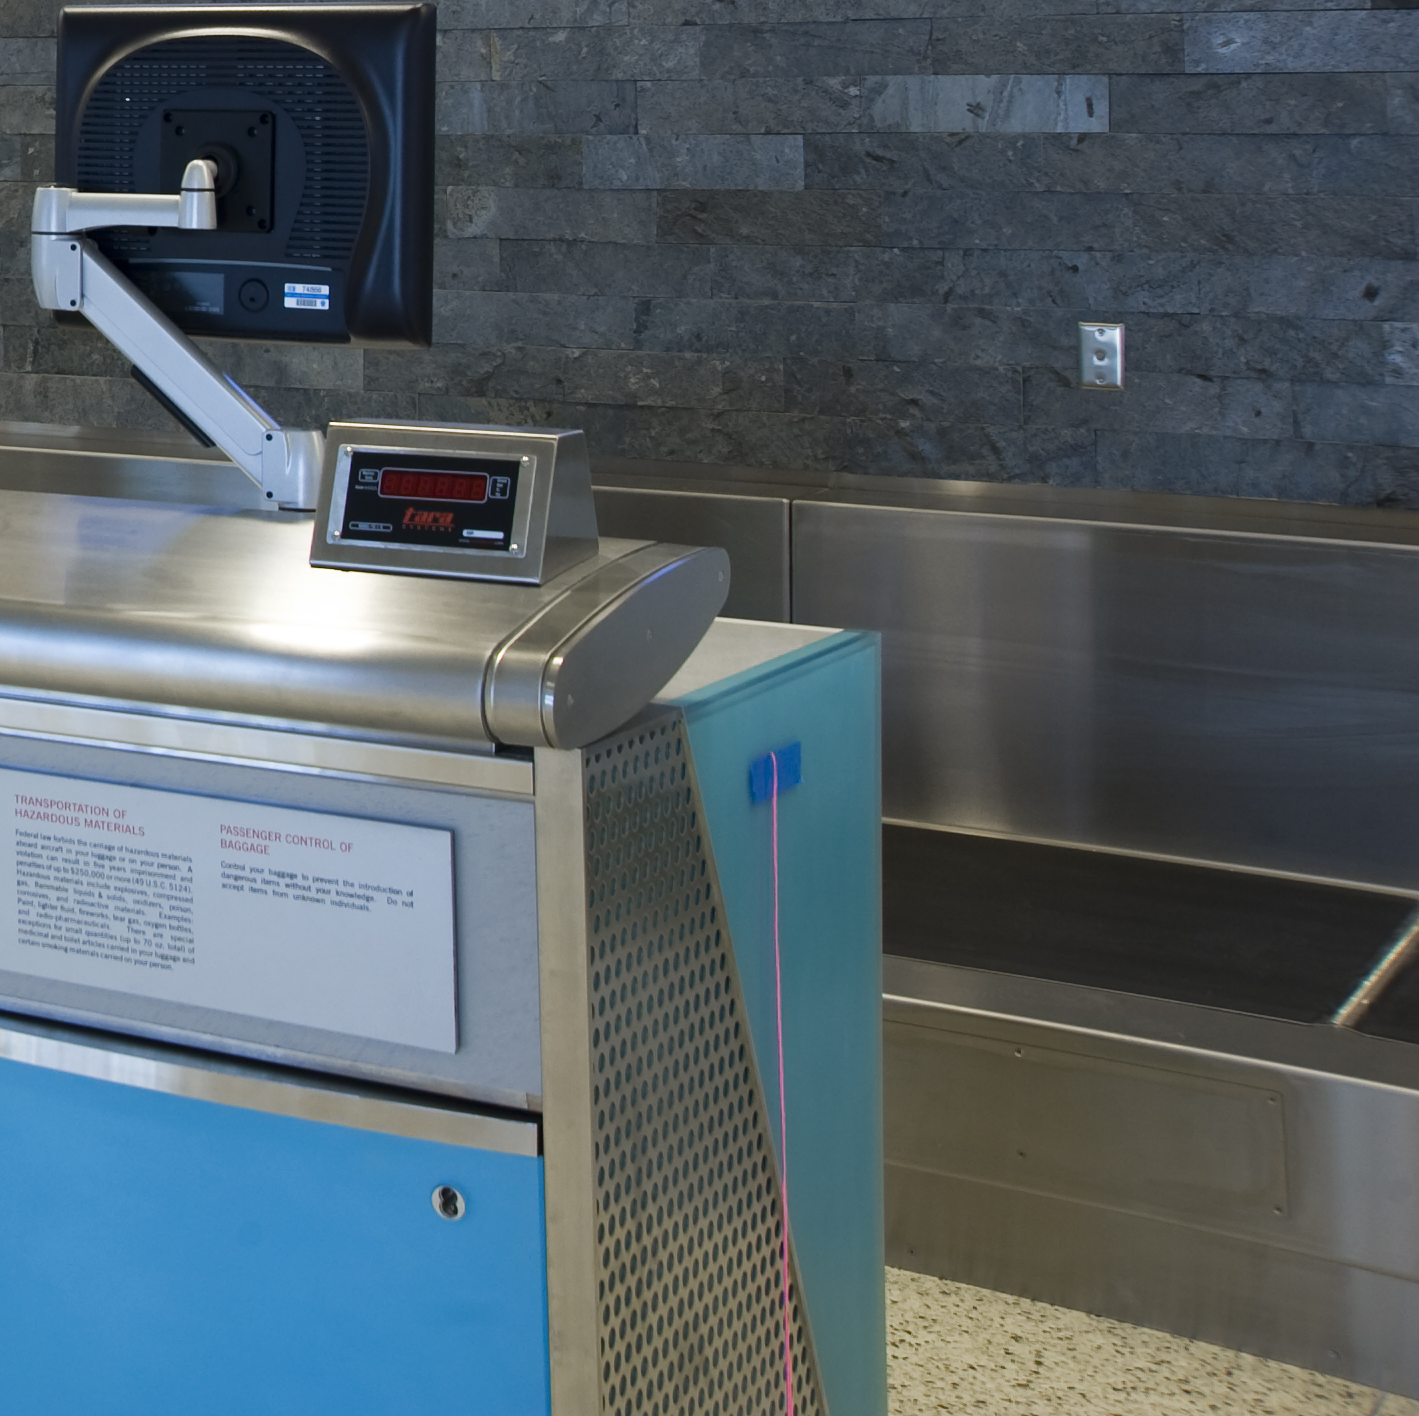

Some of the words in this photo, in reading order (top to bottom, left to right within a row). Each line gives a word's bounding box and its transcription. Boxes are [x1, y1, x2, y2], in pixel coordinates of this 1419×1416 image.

[14, 794, 109, 817] TRANSPORTATION
[113, 808, 128, 819] OF
[14, 808, 80, 827] HAZARDOUS
[84, 818, 145, 837] MATERIALS
[219, 824, 282, 842] PASSENGER
[285, 833, 335, 851] CONTROL
[339, 841, 354, 853] OF
[220, 838, 271, 856] BAGGAGE
